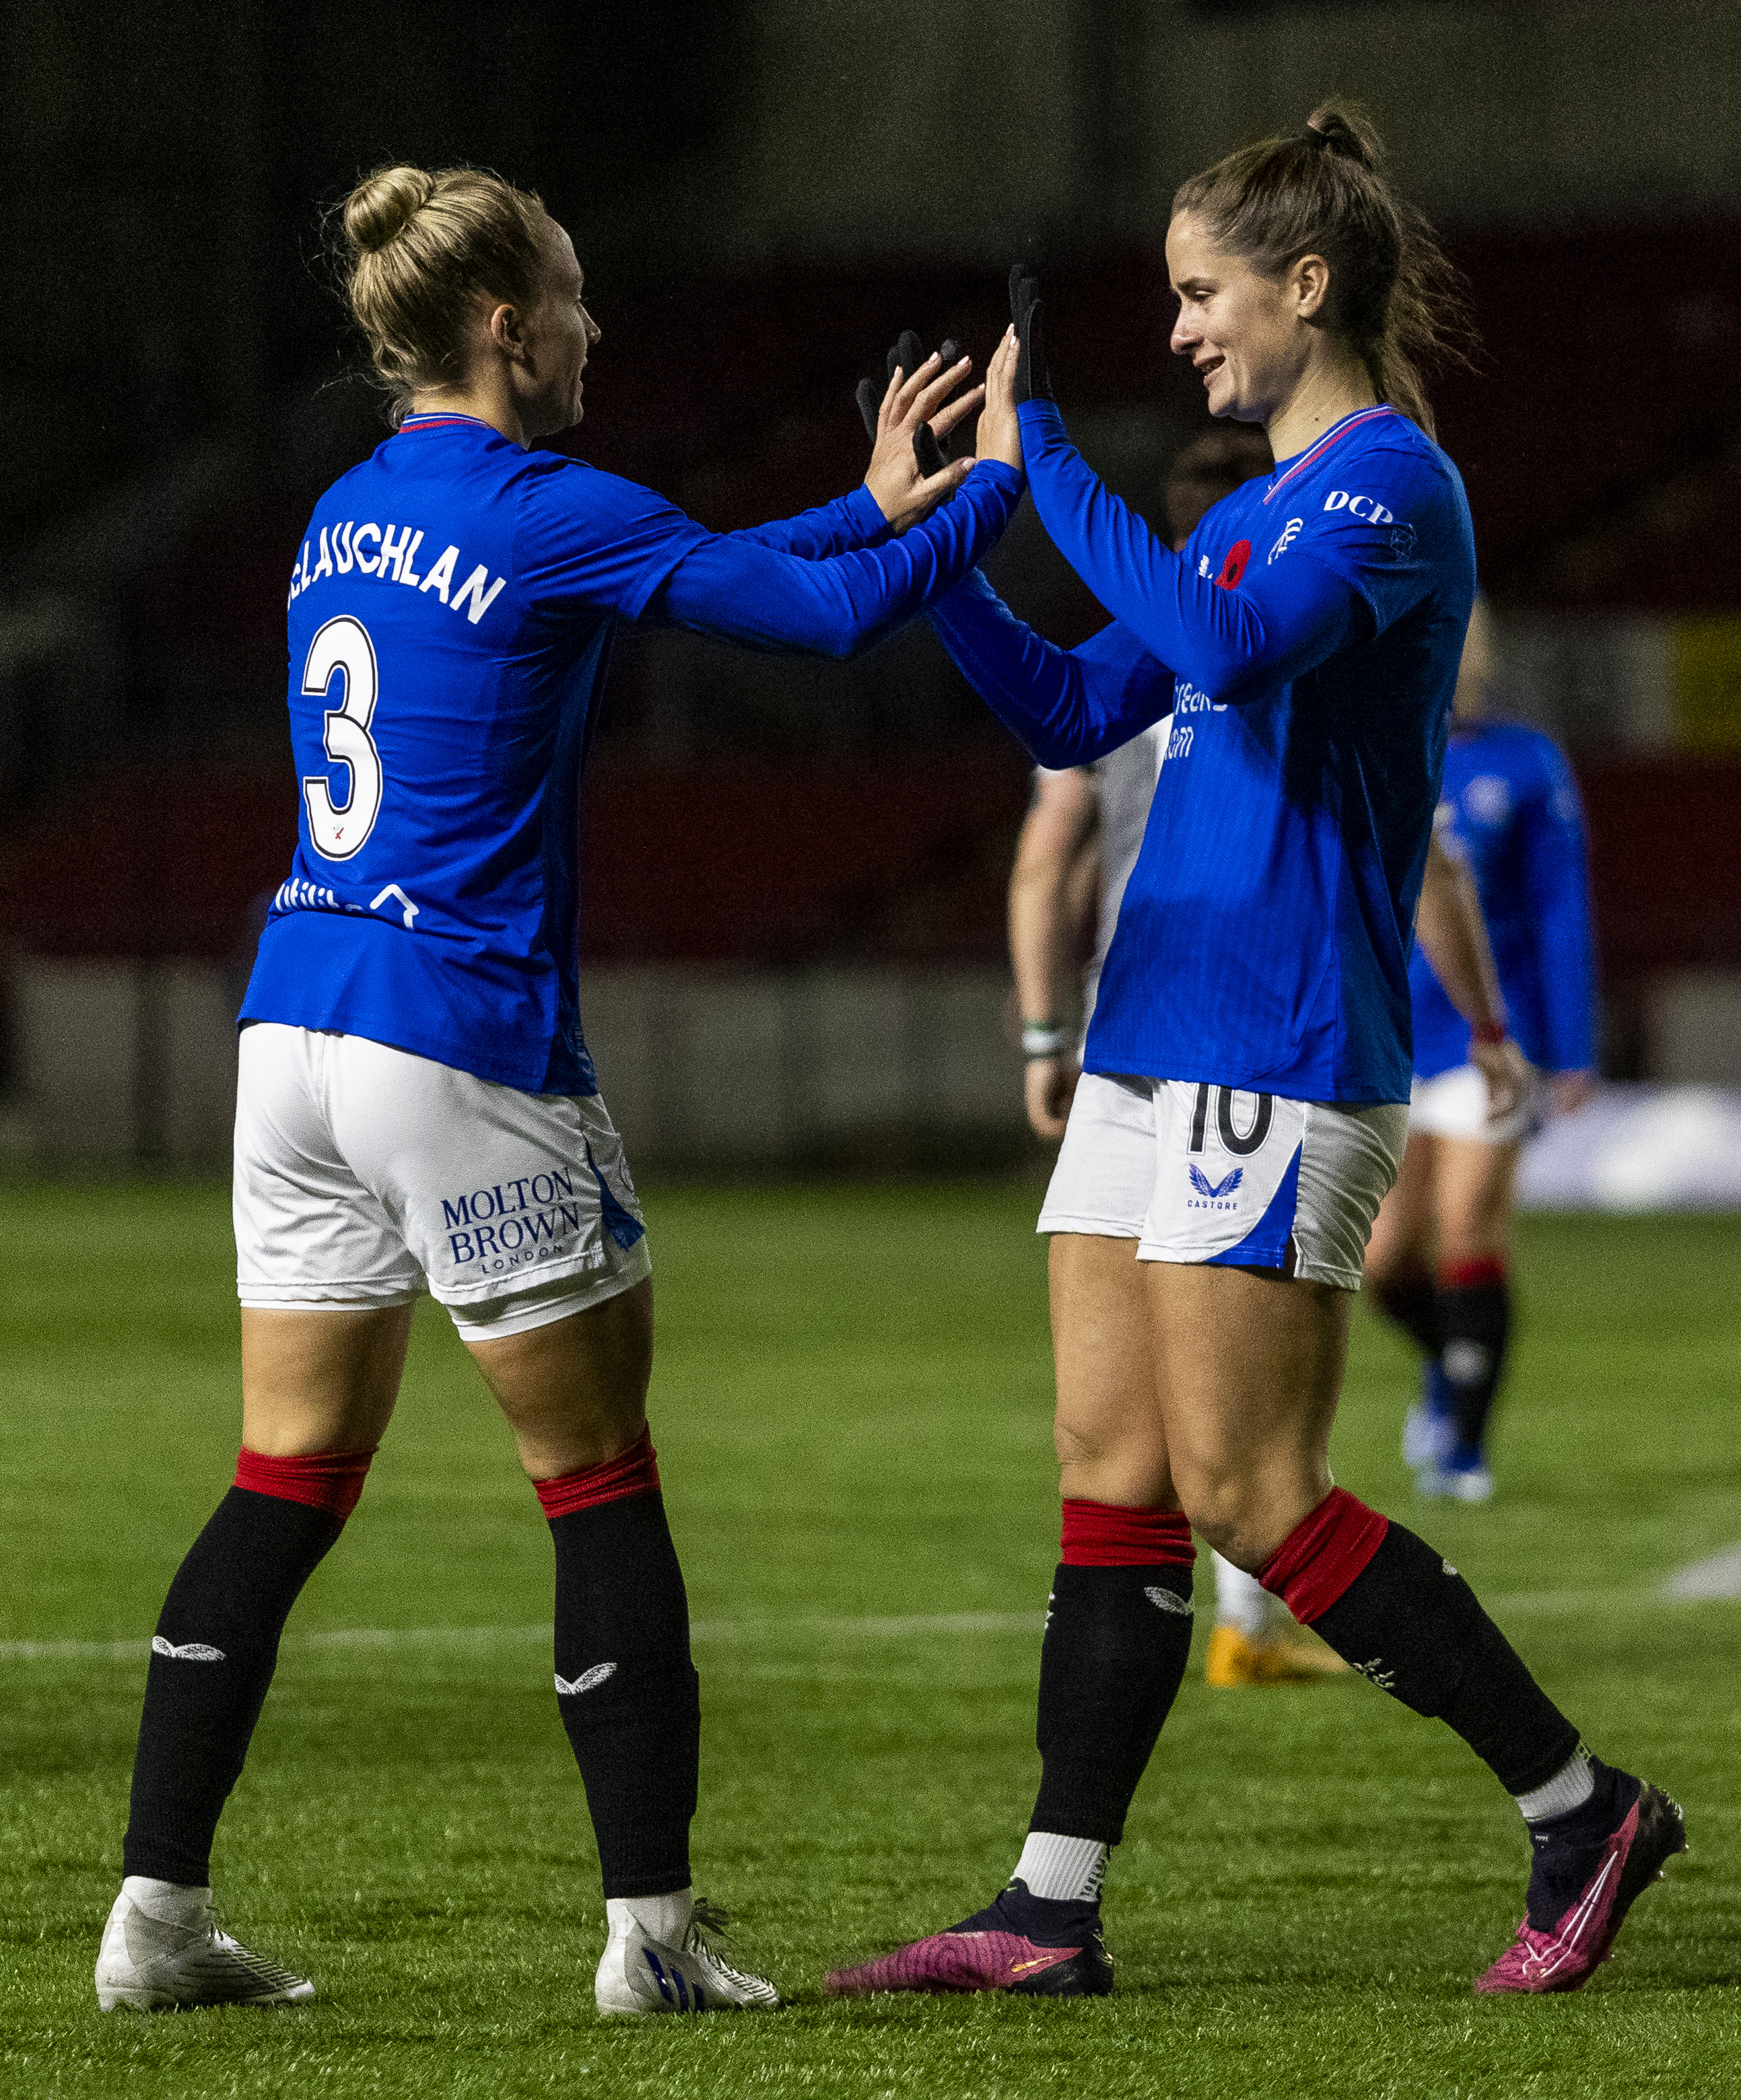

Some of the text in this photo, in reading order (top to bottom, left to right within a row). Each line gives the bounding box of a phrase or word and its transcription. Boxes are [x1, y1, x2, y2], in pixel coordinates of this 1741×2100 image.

[1323, 491, 1394, 524] DCP
[302, 615, 382, 862] 3
[1187, 1083, 1275, 1158] 10
[440, 1167, 573, 1229] MOLTON
[1188, 1199, 1238, 1211] CASTORE
[448, 1202, 580, 1264] BROWN
[481, 1245, 563, 1273] LONDON
